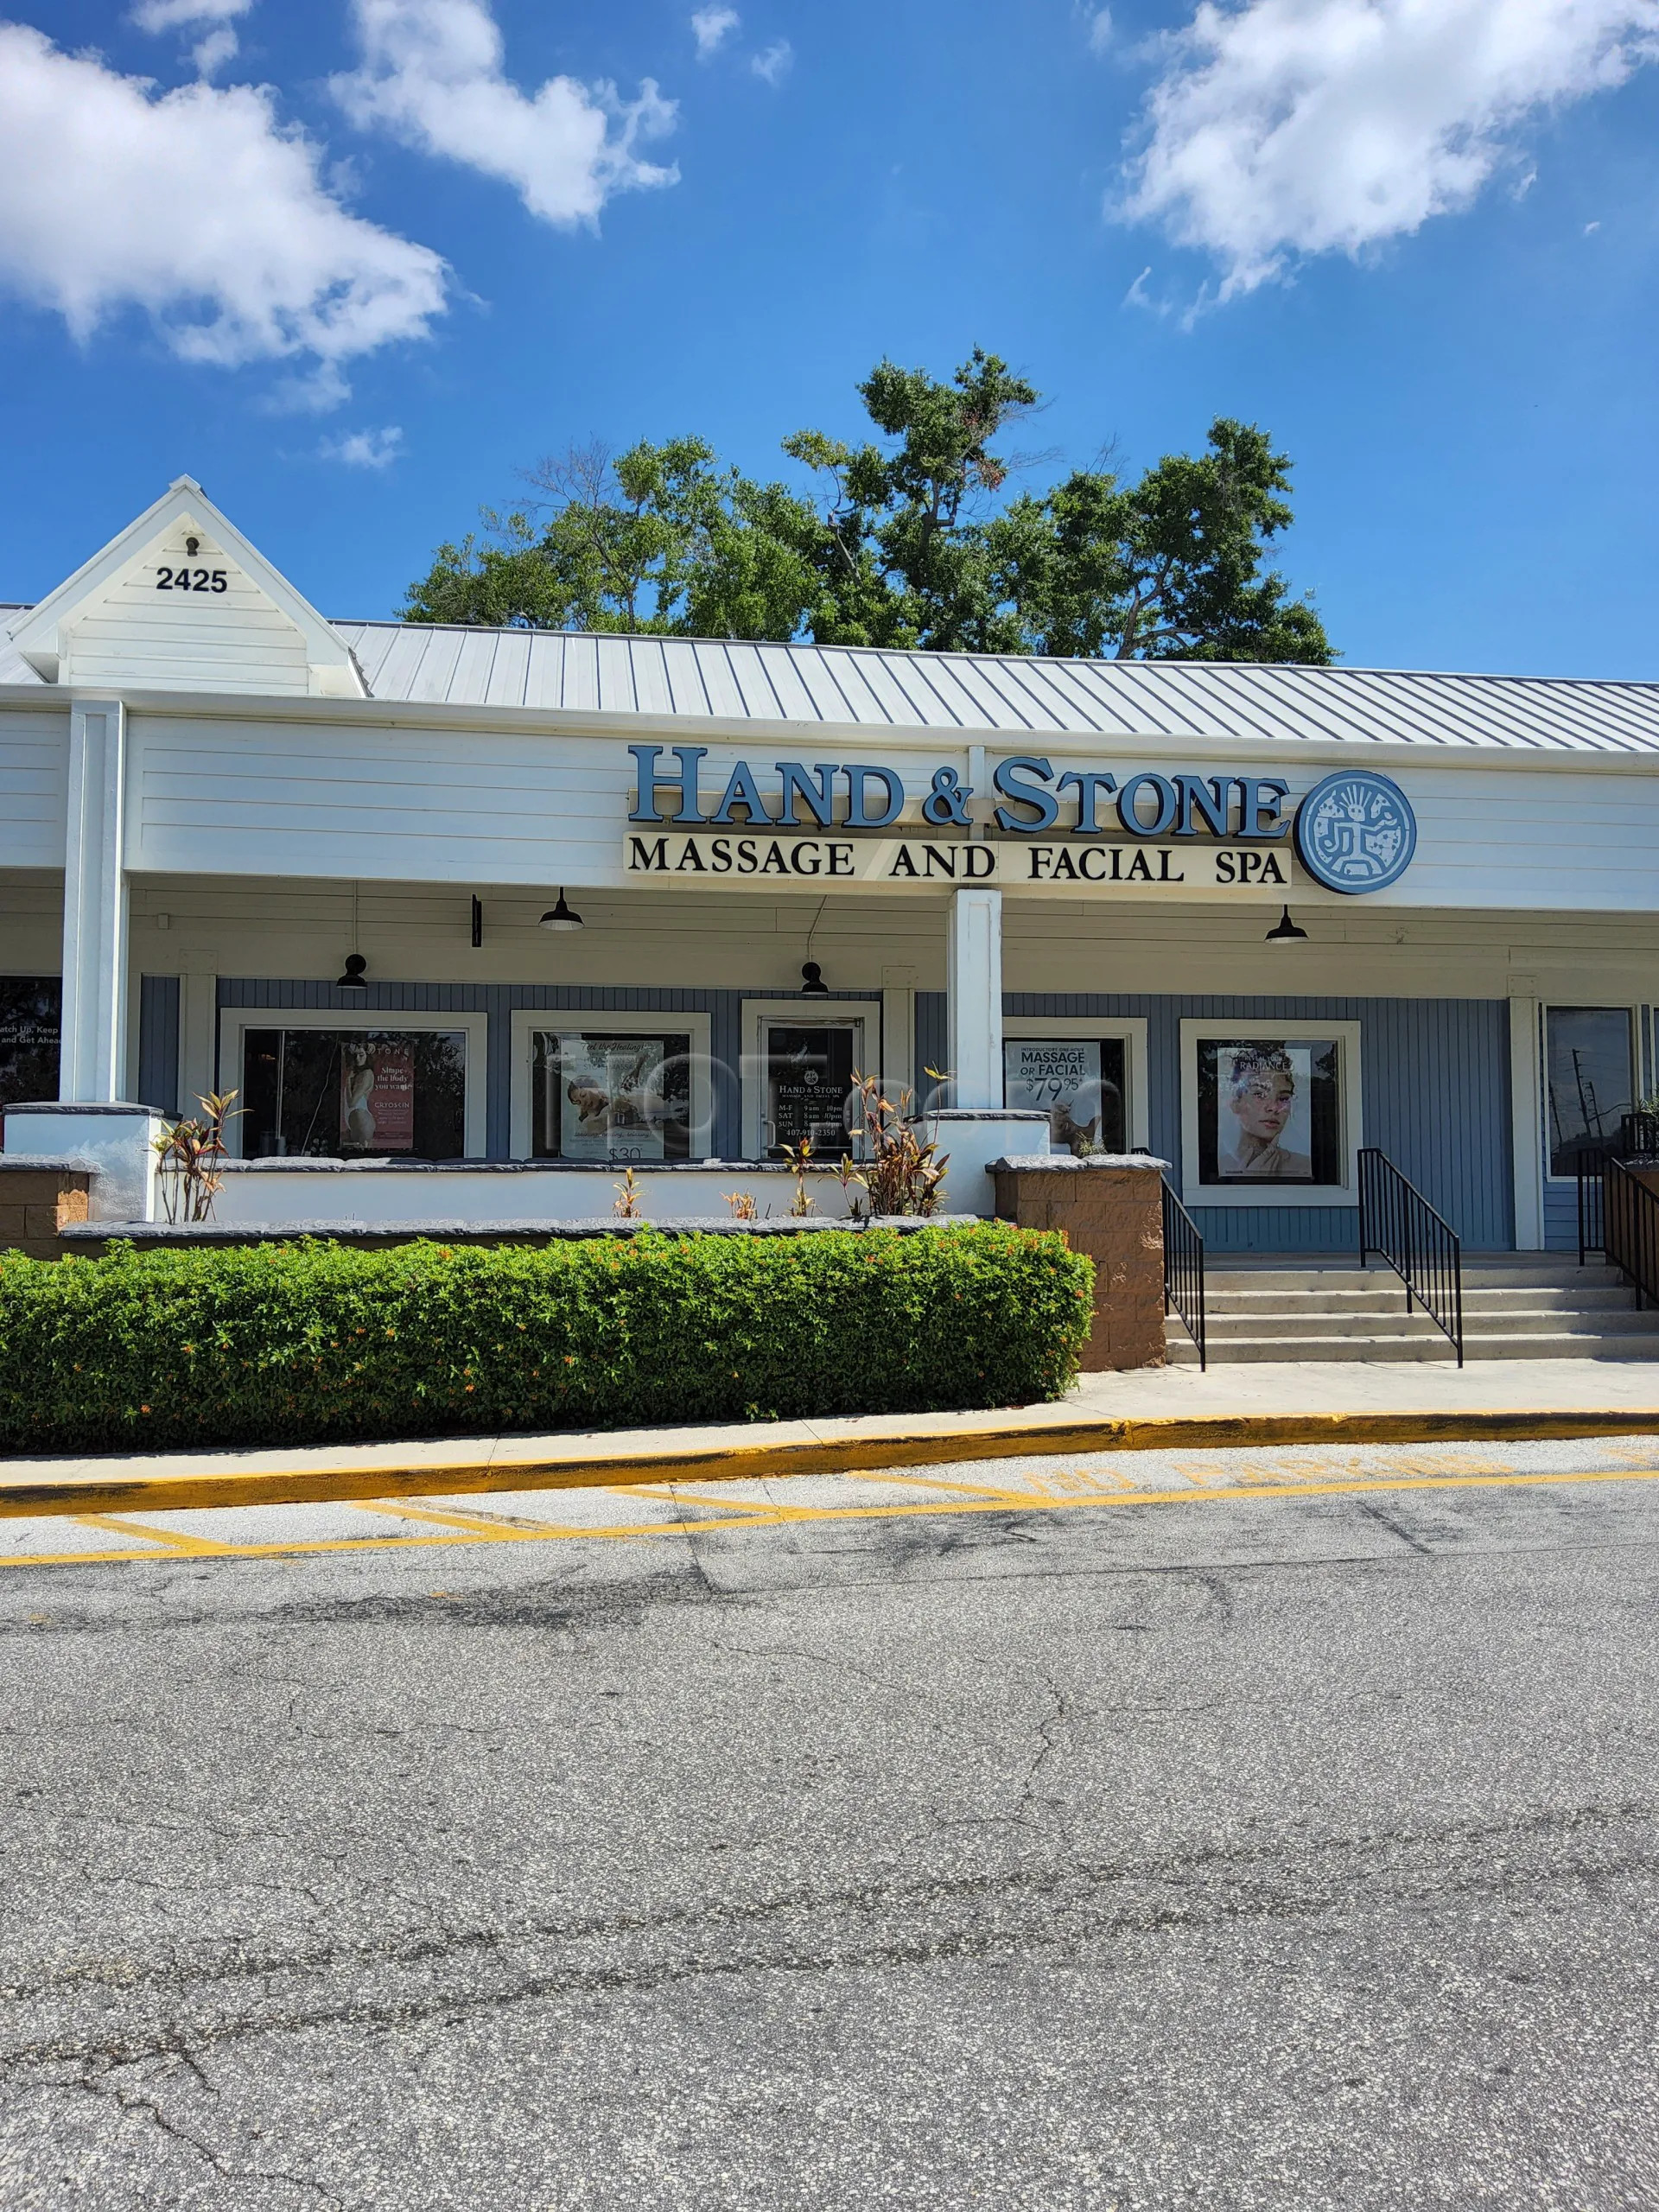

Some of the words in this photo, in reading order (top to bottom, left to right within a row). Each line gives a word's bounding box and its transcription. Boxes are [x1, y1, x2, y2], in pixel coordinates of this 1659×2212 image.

[156, 567, 227, 594] 2425
[628, 744, 905, 830] HAND
[921, 765, 974, 828] &
[994, 755, 1291, 840] STONE
[628, 836, 855, 876] MASSAGE
[888, 843, 996, 878] AND
[1027, 847, 1185, 882] FACIAL
[1215, 851, 1287, 886] SPA
[36, 1027, 58, 1035] Keep
[1021, 1052, 1085, 1064] MASSAGE
[1020, 1067, 1035, 1076] OR
[1038, 1064, 1086, 1076] FACIAL
[1239, 1061, 1288, 1071] RADIANCE
[390, 1074, 409, 1083] body
[1021, 1466, 1139, 1494] NO
[1169, 1452, 1516, 1485] PARKING
